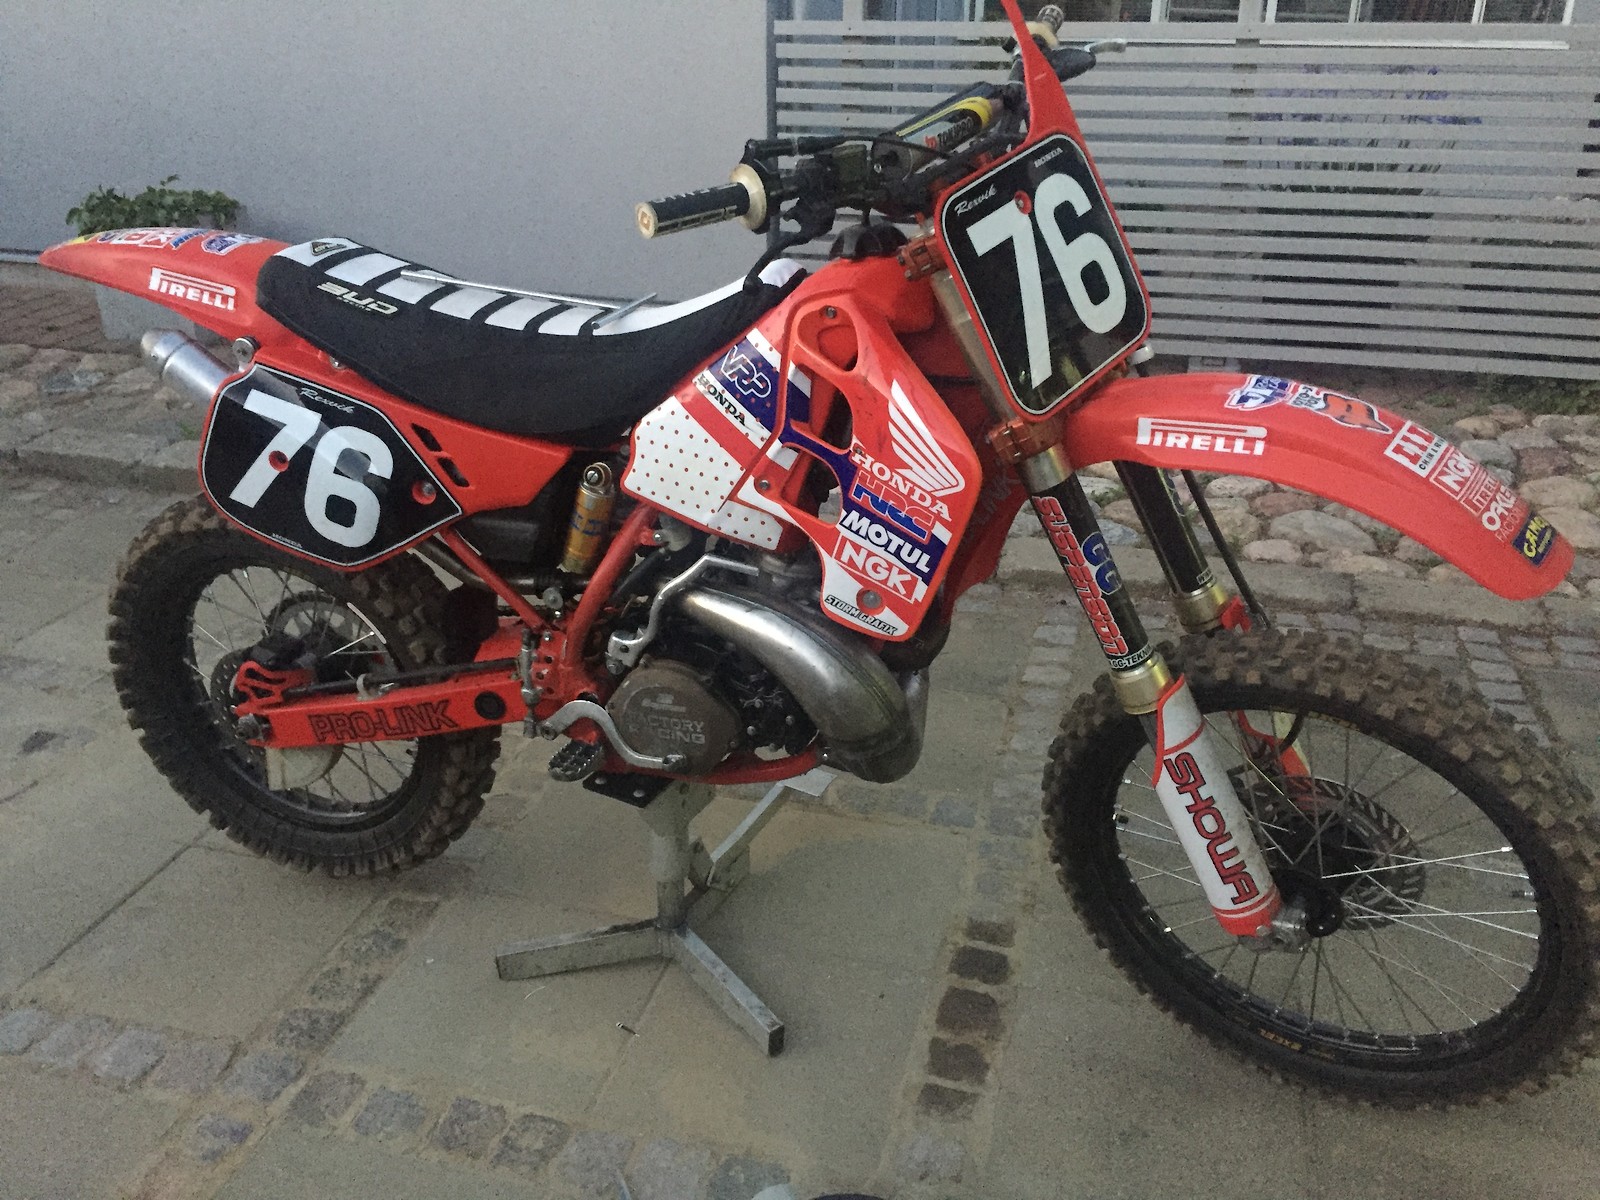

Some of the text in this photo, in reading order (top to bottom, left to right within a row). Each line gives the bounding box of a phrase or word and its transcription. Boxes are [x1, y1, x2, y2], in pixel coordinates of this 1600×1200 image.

[1034, 147, 1064, 168] HONDA
[149, 267, 236, 311] PIRELLI
[966, 172, 1127, 389] 76
[697, 373, 746, 426] HONDA
[1136, 416, 1268, 456] PIRELLI
[229, 388, 394, 548] 76
[851, 452, 952, 522] HONDA
[1437, 451, 1478, 492] NGK
[851, 469, 935, 541] HRC
[1481, 485, 1517, 531] OAKLE
[839, 509, 931, 574] MOTUL
[1523, 515, 1553, 559] CAME
[840, 539, 912, 595] NGK
[824, 595, 898, 636] STORM GRAFIX
[308, 700, 459, 742] PRO-LINK
[1163, 751, 1260, 906] SHOWA
